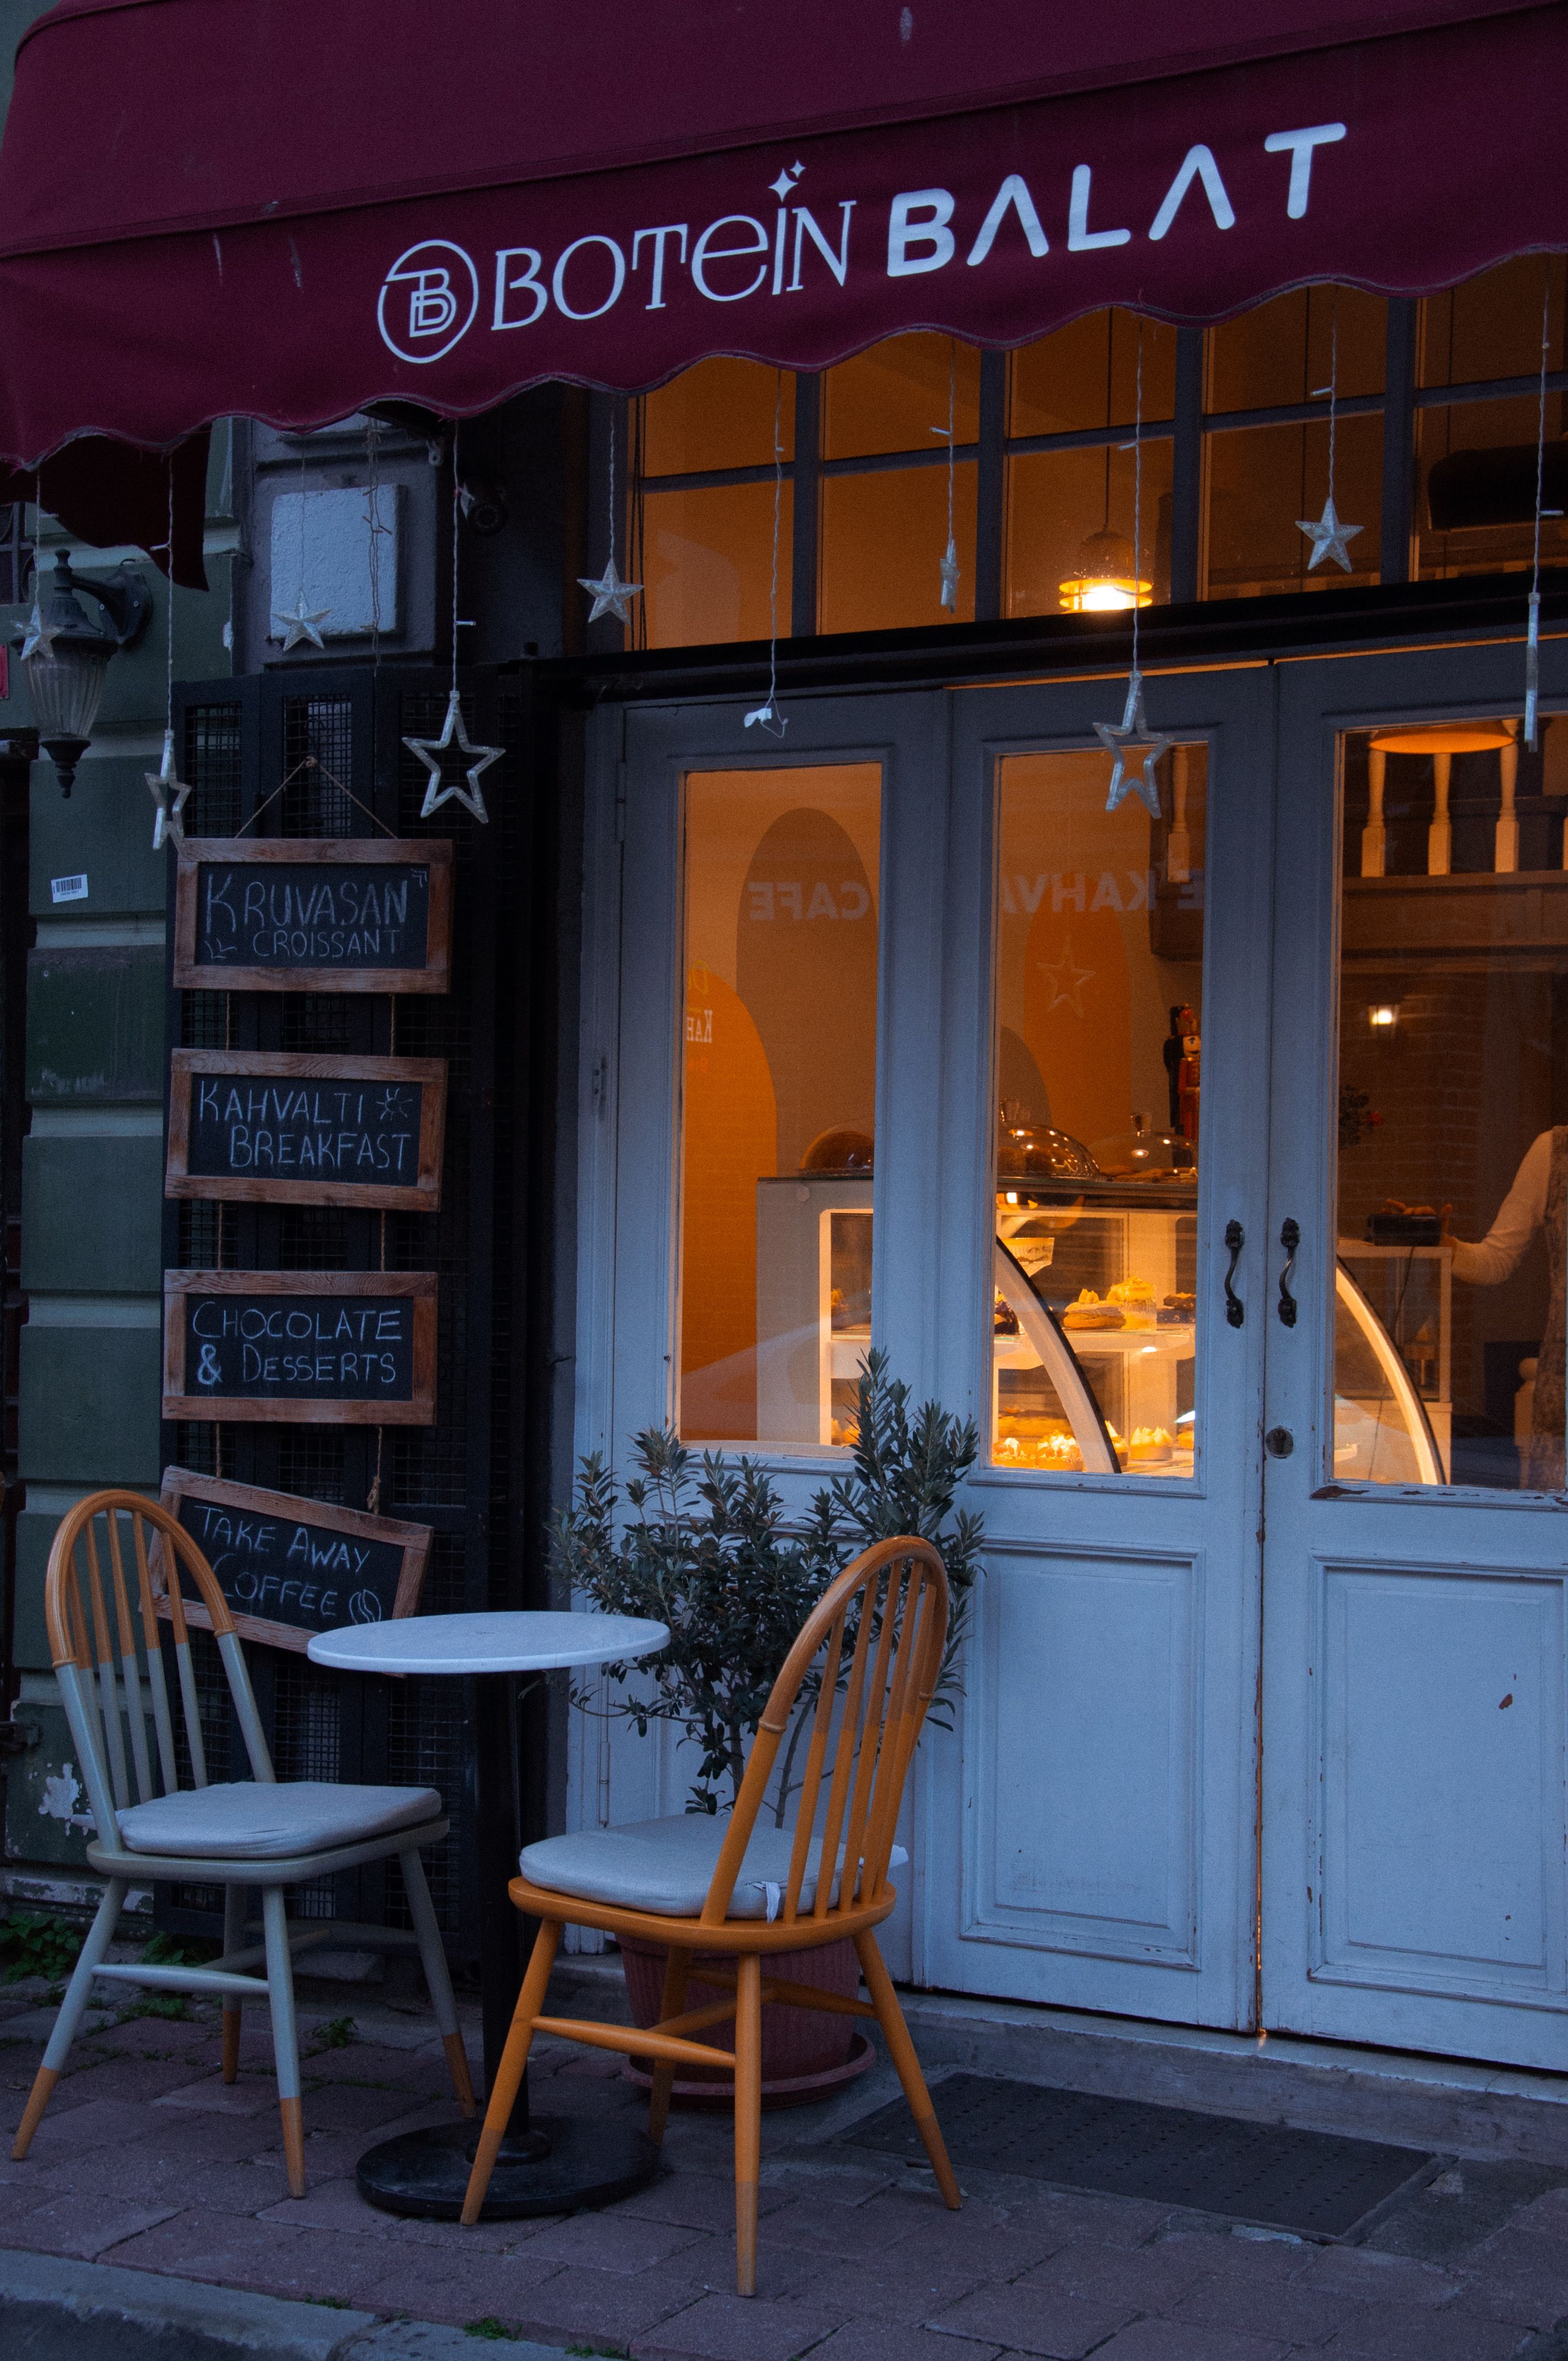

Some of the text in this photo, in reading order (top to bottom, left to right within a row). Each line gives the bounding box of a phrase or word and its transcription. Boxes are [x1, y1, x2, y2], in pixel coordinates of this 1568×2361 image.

[205, 873, 409, 933] KRUVASAN
[252, 929, 401, 957] CROISSANT
[199, 1080, 364, 1124] KAHVALTI
[230, 1124, 411, 1171] BREAKFAST
[193, 1301, 402, 1341] CHOCOLATE
[197, 1343, 396, 1386] & DESSERTS
[194, 1505, 371, 1574] TAKE AWAY
